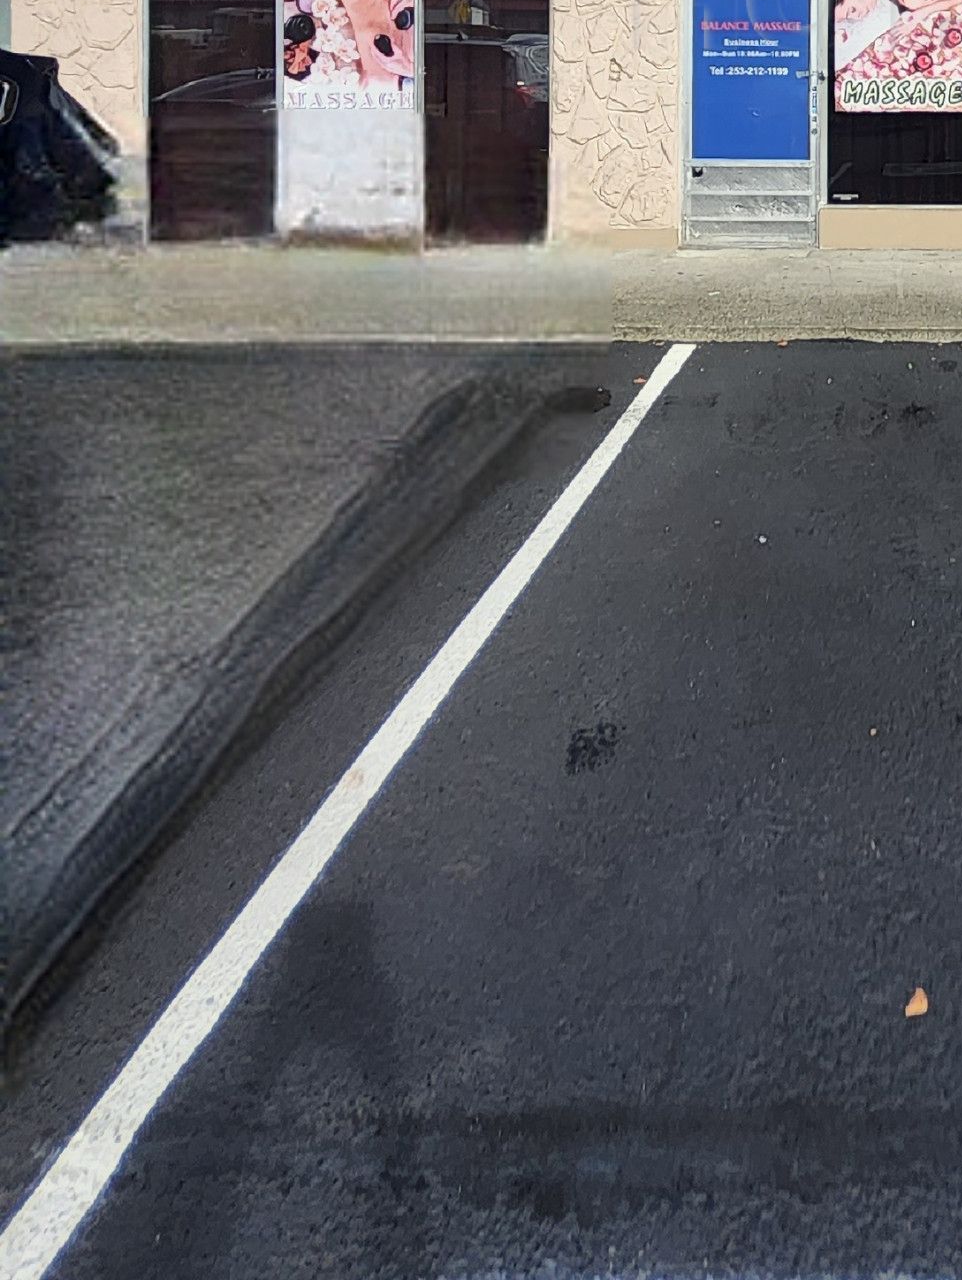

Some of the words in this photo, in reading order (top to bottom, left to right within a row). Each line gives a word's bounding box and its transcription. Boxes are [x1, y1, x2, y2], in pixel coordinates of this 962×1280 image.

[701, 21, 750, 31] BALANCE
[753, 21, 801, 31] MASSAGE
[285, 92, 414, 110] MASSAGE
